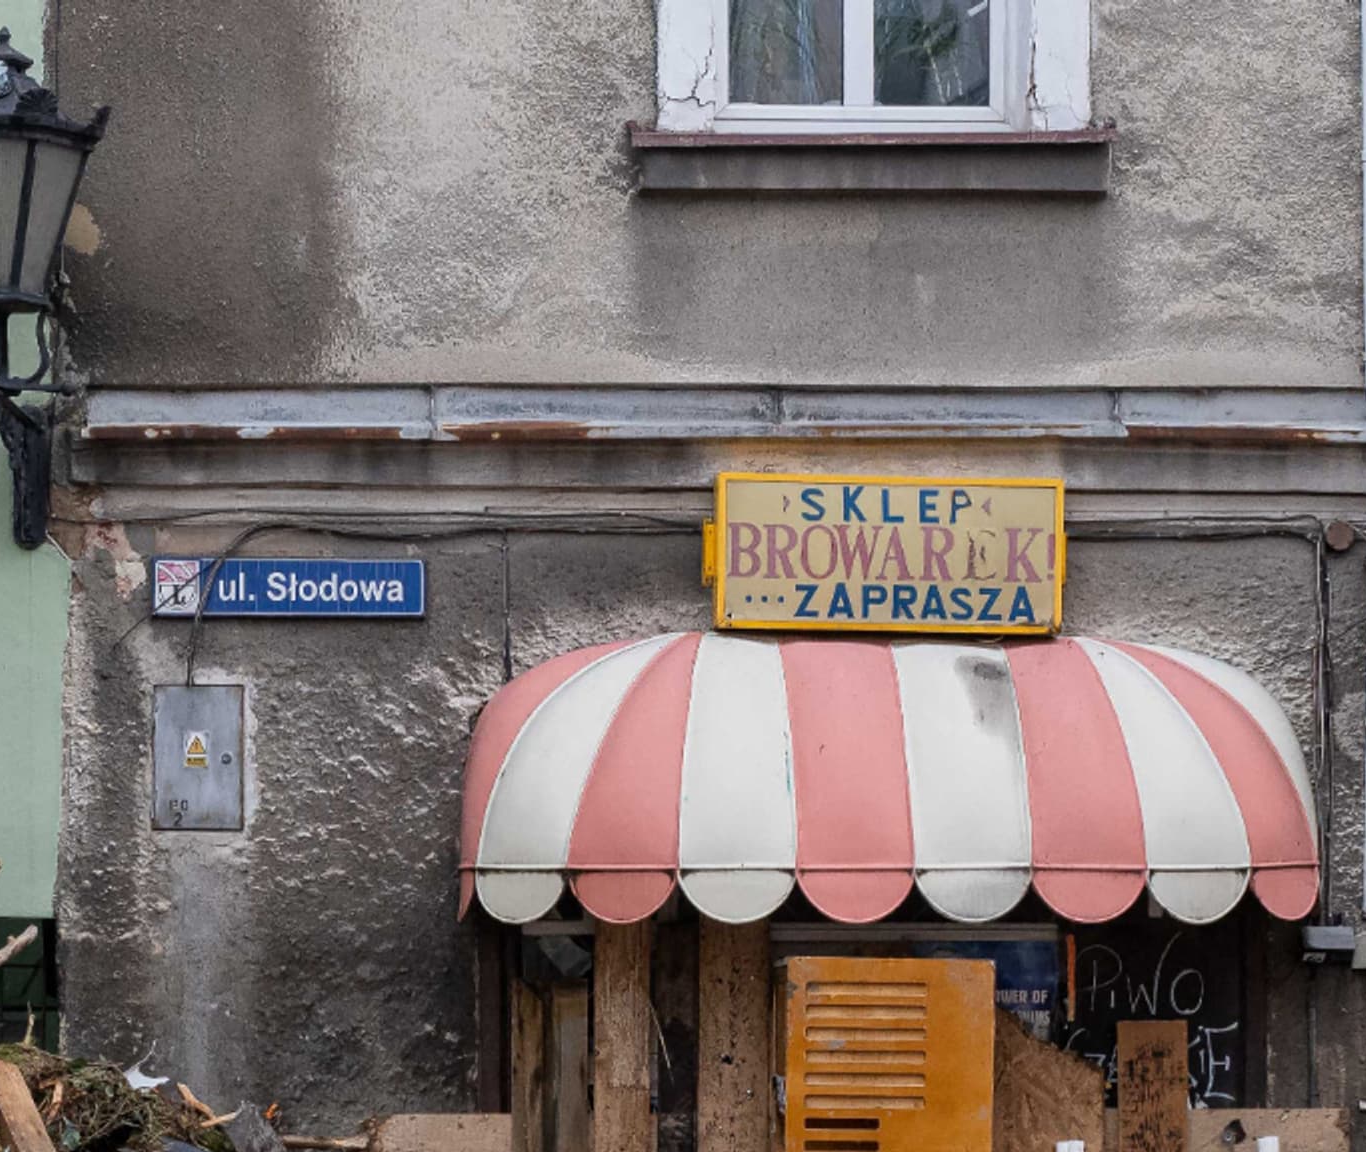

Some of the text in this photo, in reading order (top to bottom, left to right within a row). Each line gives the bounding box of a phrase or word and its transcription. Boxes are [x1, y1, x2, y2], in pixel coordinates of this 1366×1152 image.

[801, 486, 972, 525] SKLEP
[219, 572, 404, 602] ul. Słodowa
[1076, 932, 1204, 1015] PIWO
[1032, 989, 1048, 1004] OF
